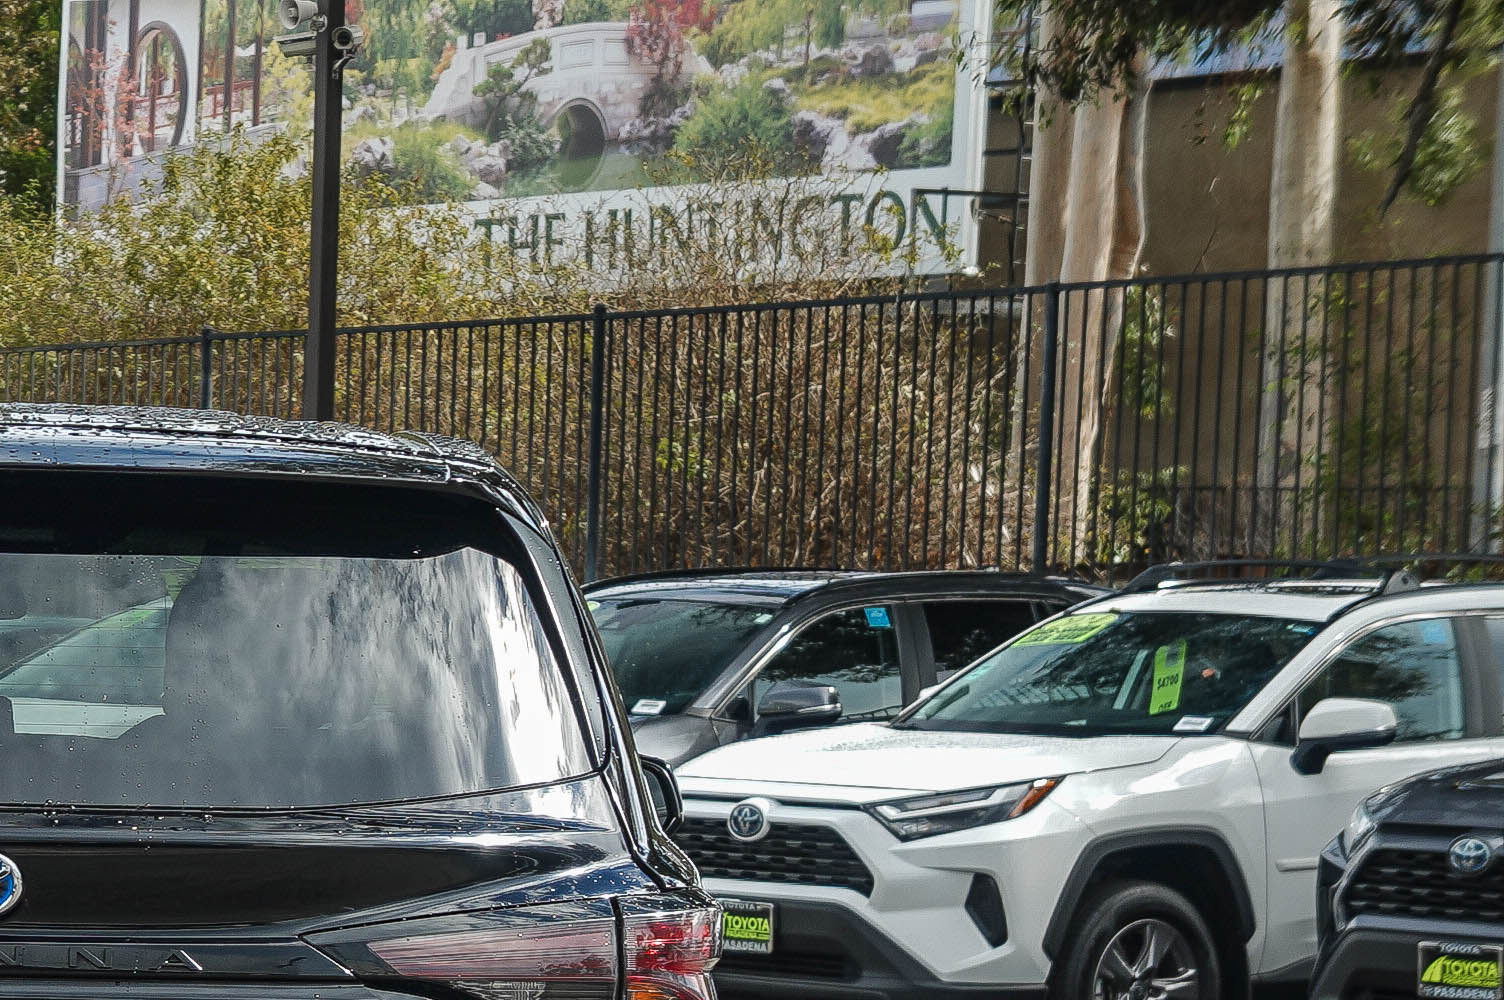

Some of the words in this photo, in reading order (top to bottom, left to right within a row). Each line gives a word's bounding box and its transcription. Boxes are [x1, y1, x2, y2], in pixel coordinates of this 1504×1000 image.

[473, 211, 565, 272] THE
[727, 915, 769, 930] TOYOTA
[722, 940, 767, 952] ASADENA
[1443, 960, 1498, 976] TOYOTA
